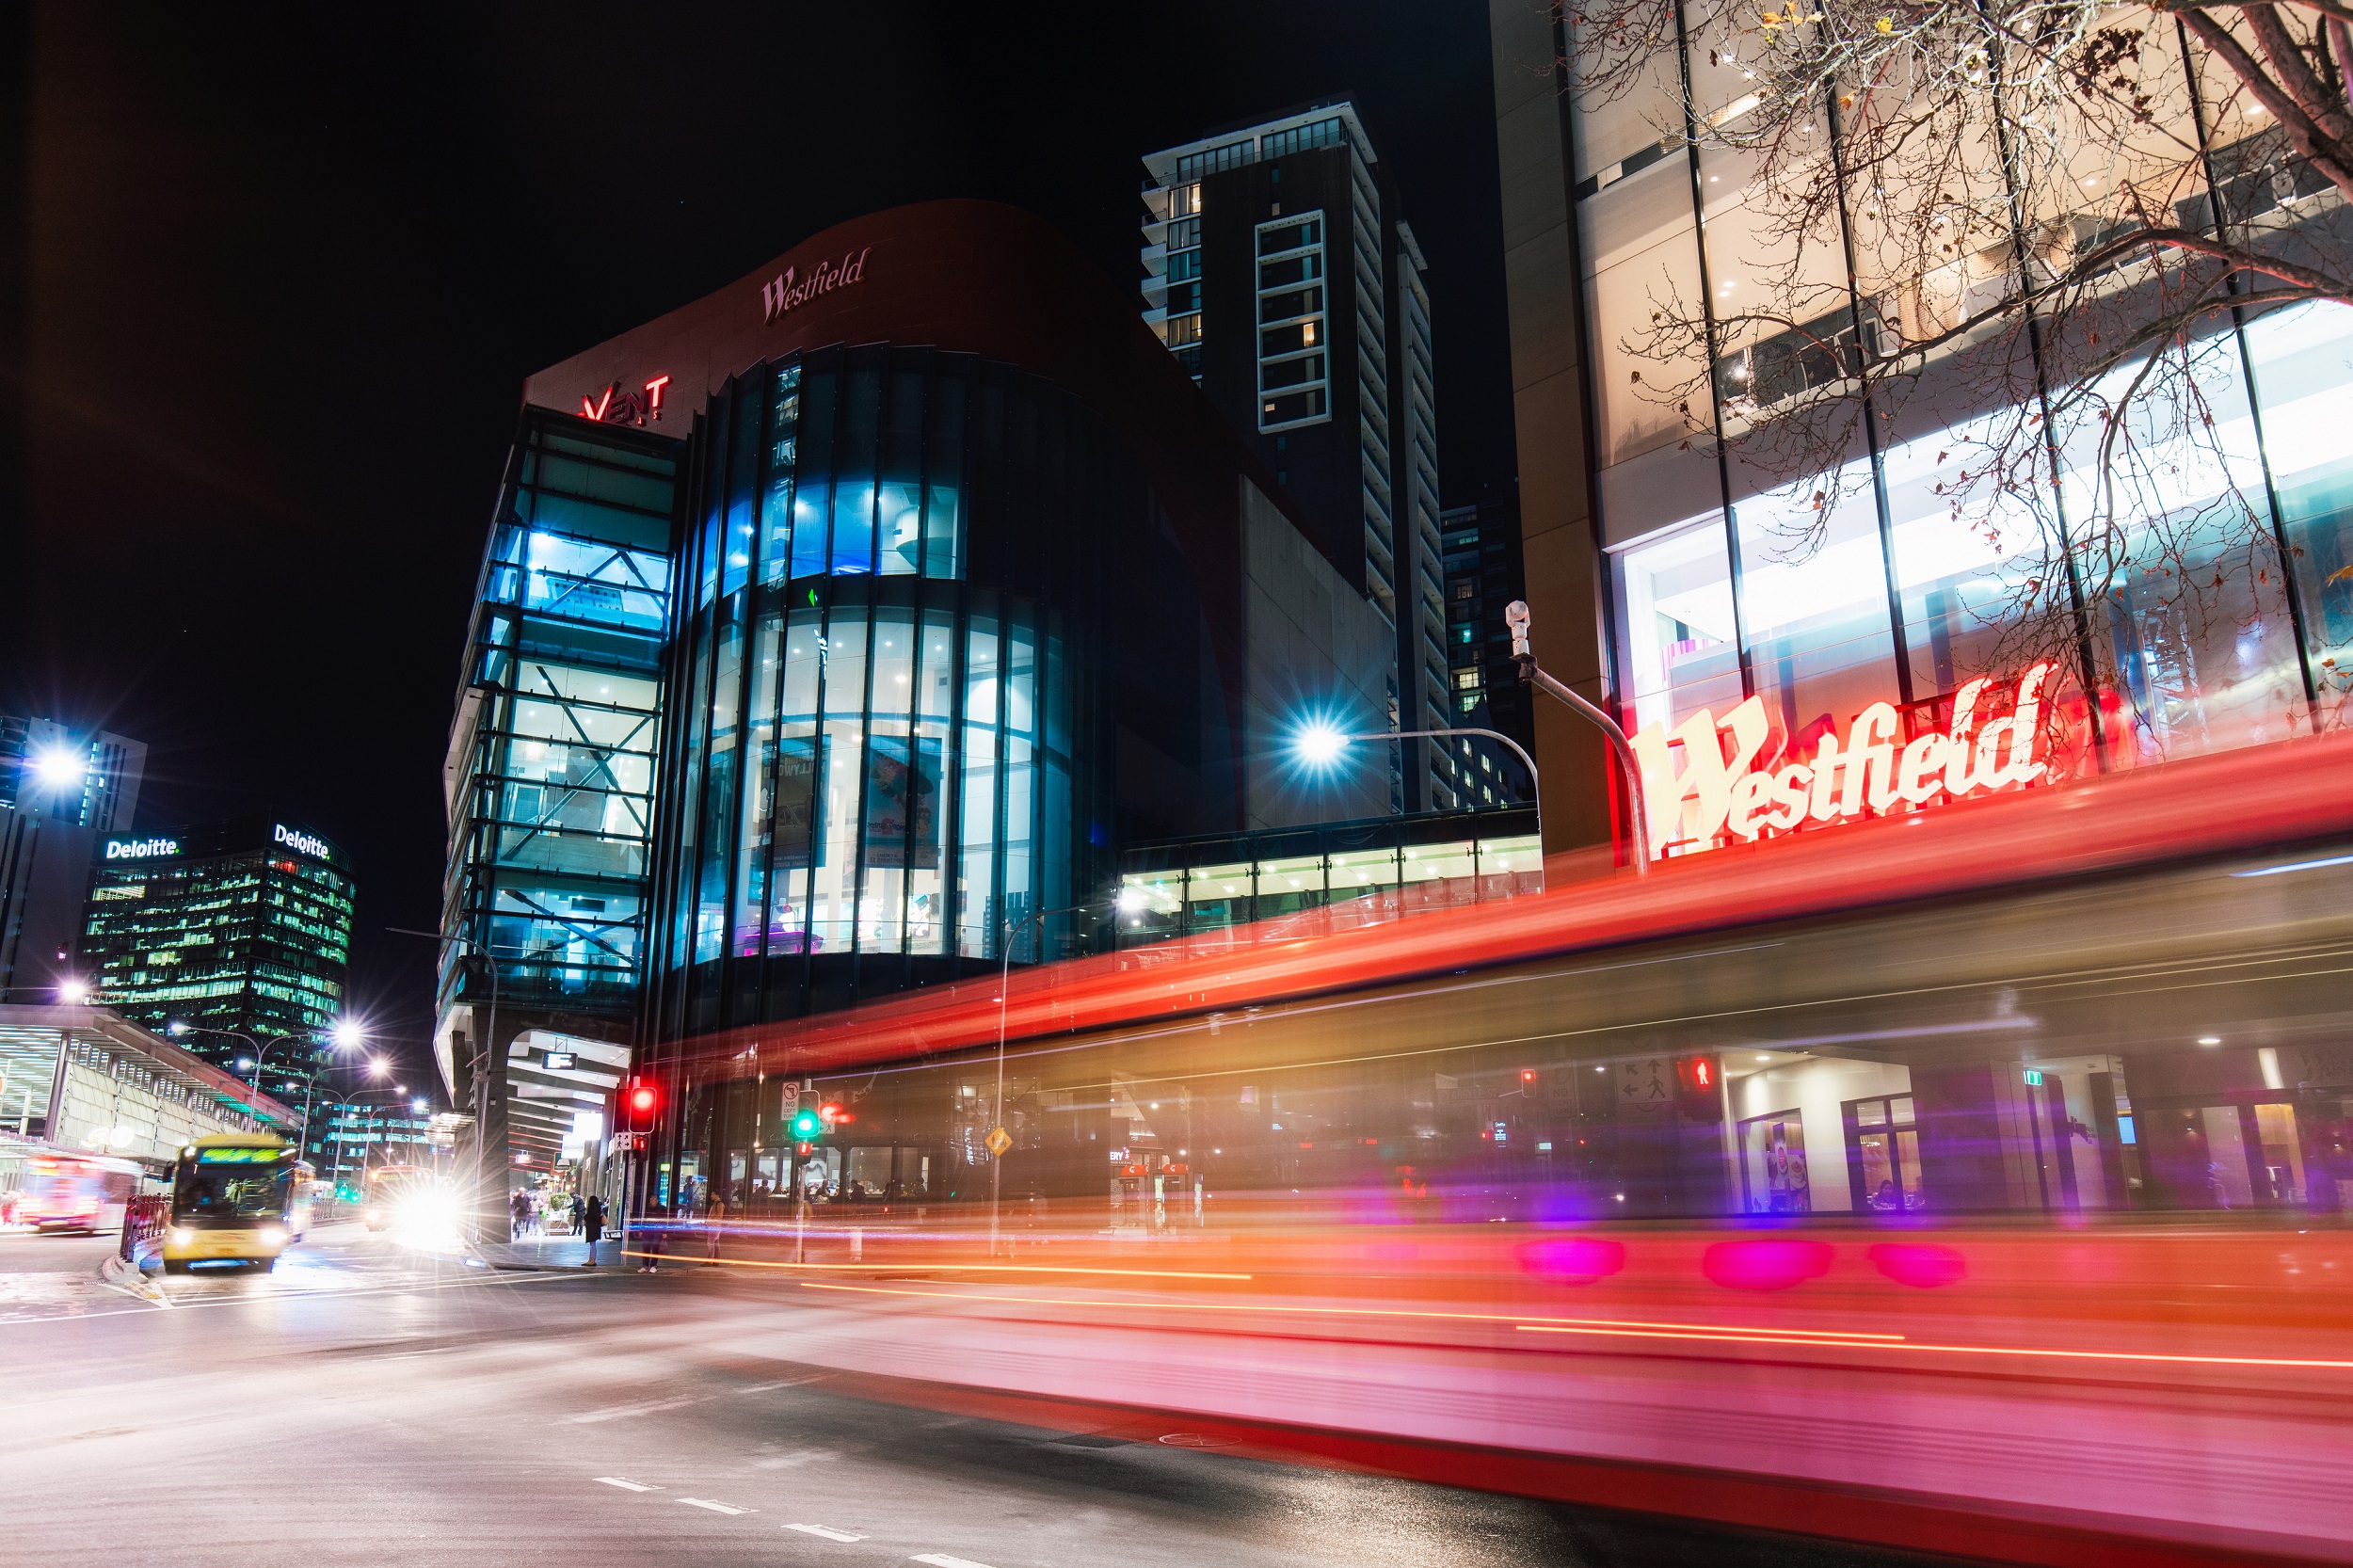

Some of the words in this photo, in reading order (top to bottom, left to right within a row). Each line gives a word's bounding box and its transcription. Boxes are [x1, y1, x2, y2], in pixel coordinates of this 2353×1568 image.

[761, 247, 872, 326] Westfield
[1629, 663, 2059, 854] Westfield
[1553, 1088, 1568, 1097] NO
